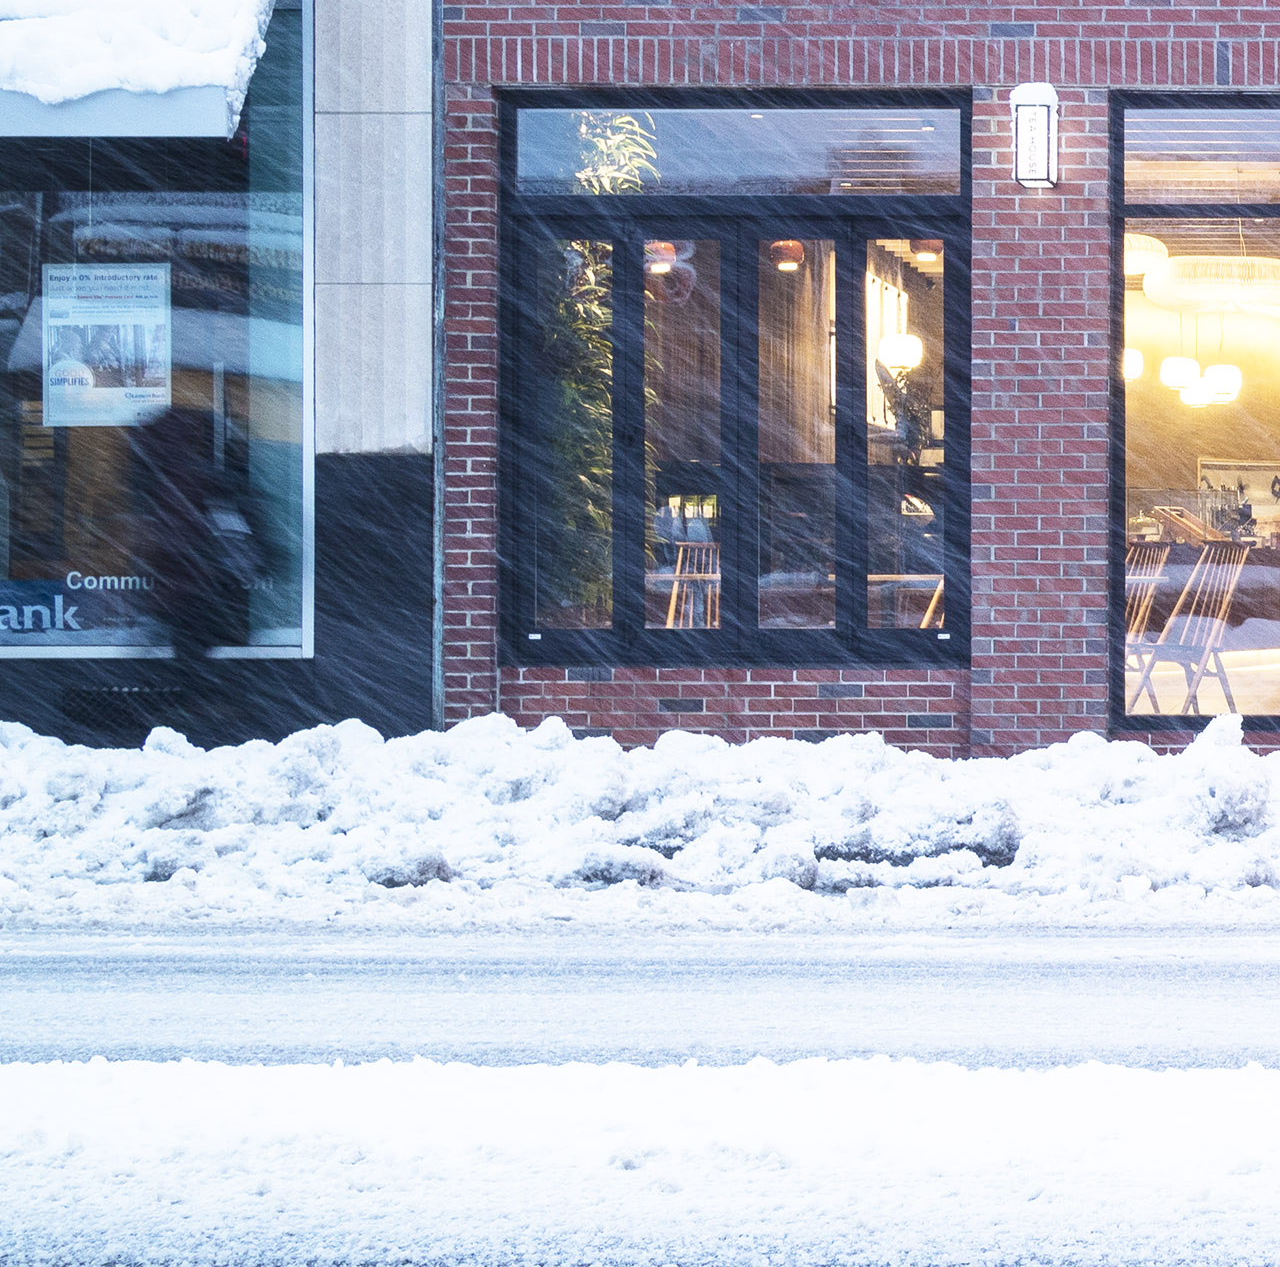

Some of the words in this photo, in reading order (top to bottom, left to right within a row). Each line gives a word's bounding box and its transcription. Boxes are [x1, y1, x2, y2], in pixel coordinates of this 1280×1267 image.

[1028, 111, 1037, 132] TEA
[1028, 136, 1037, 175] HOUSE
[49, 274, 70, 282] Enjoy
[94, 274, 140, 282] introductory
[49, 377, 90, 387] SIMPLIFIES
[0, 594, 82, 630] ank
